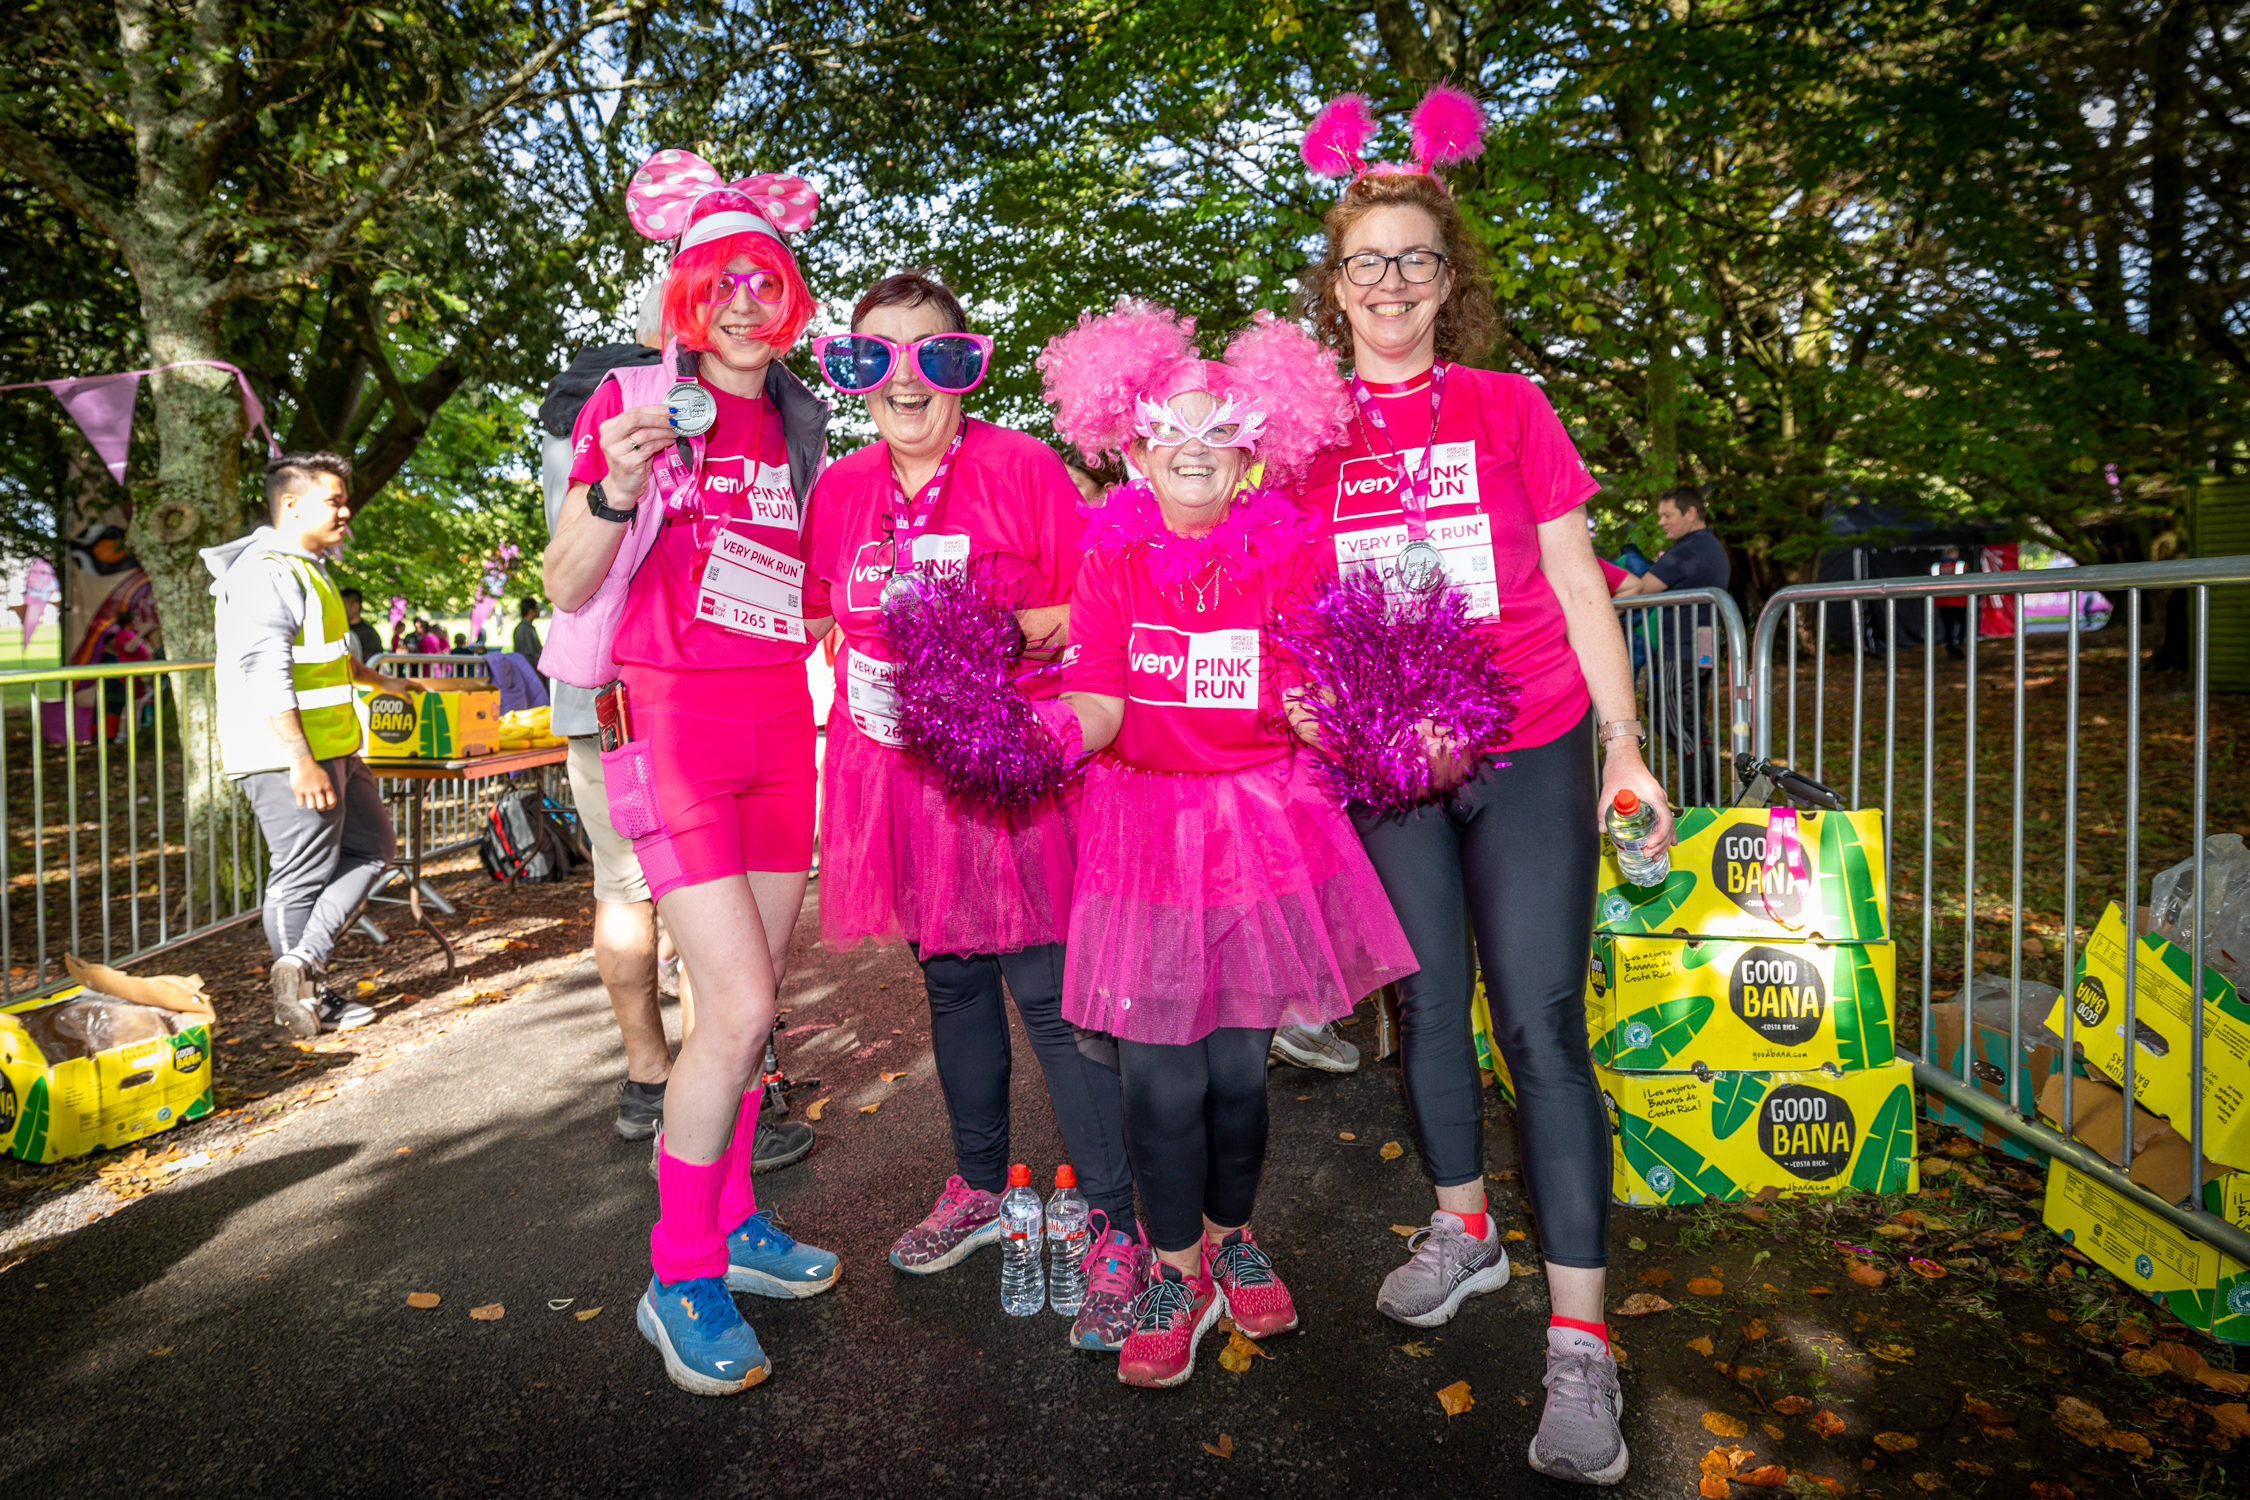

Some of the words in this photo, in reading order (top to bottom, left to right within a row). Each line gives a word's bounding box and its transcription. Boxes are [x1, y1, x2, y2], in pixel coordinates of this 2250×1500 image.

[752, 486, 794, 503] PINK
[1344, 476, 1400, 496] very
[1428, 480, 1465, 498] UN
[756, 502, 794, 521] RUN
[1347, 535, 1391, 552] VERY
[1397, 528, 1437, 546] PK
[1442, 523, 1479, 540] RUN
[723, 538, 752, 559] VERY
[750, 550, 776, 570] PINK
[776, 560, 799, 579] RUN
[855, 563, 893, 582] ver
[702, 600, 716, 612] very
[733, 608, 767, 629] 1265
[774, 621, 788, 632] very
[853, 657, 877, 677] VERY
[1131, 652, 1185, 681] very
[1194, 657, 1253, 678] PINK
[1194, 679, 1246, 699] RUN
[372, 699, 404, 714] GOOD
[370, 713, 414, 731] BANA
[1725, 836, 1782, 861] GOO
[1642, 949, 1673, 962] mejores
[1661, 958, 1673, 968] de
[1591, 969, 1606, 989] BANA
[1624, 973, 1652, 983] Costa
[1741, 960, 1798, 985] GOOD
[1743, 985, 1820, 1018] BANA
[2076, 982, 2107, 1015] BANA
[2076, 1002, 2099, 1025] GOOD
[174, 1045, 196, 1060] GOOD
[175, 1051, 203, 1070] BANA
[1752, 1047, 1808, 1062] goodbana.com
[1666, 1083, 1697, 1096] mejores
[1686, 1092, 1698, 1102] de
[1647, 1108, 1676, 1119] Costa
[1770, 1097, 1827, 1122] GOOD
[1773, 1121, 1850, 1156] BANA
[1581, 1340, 1596, 1349] asics
